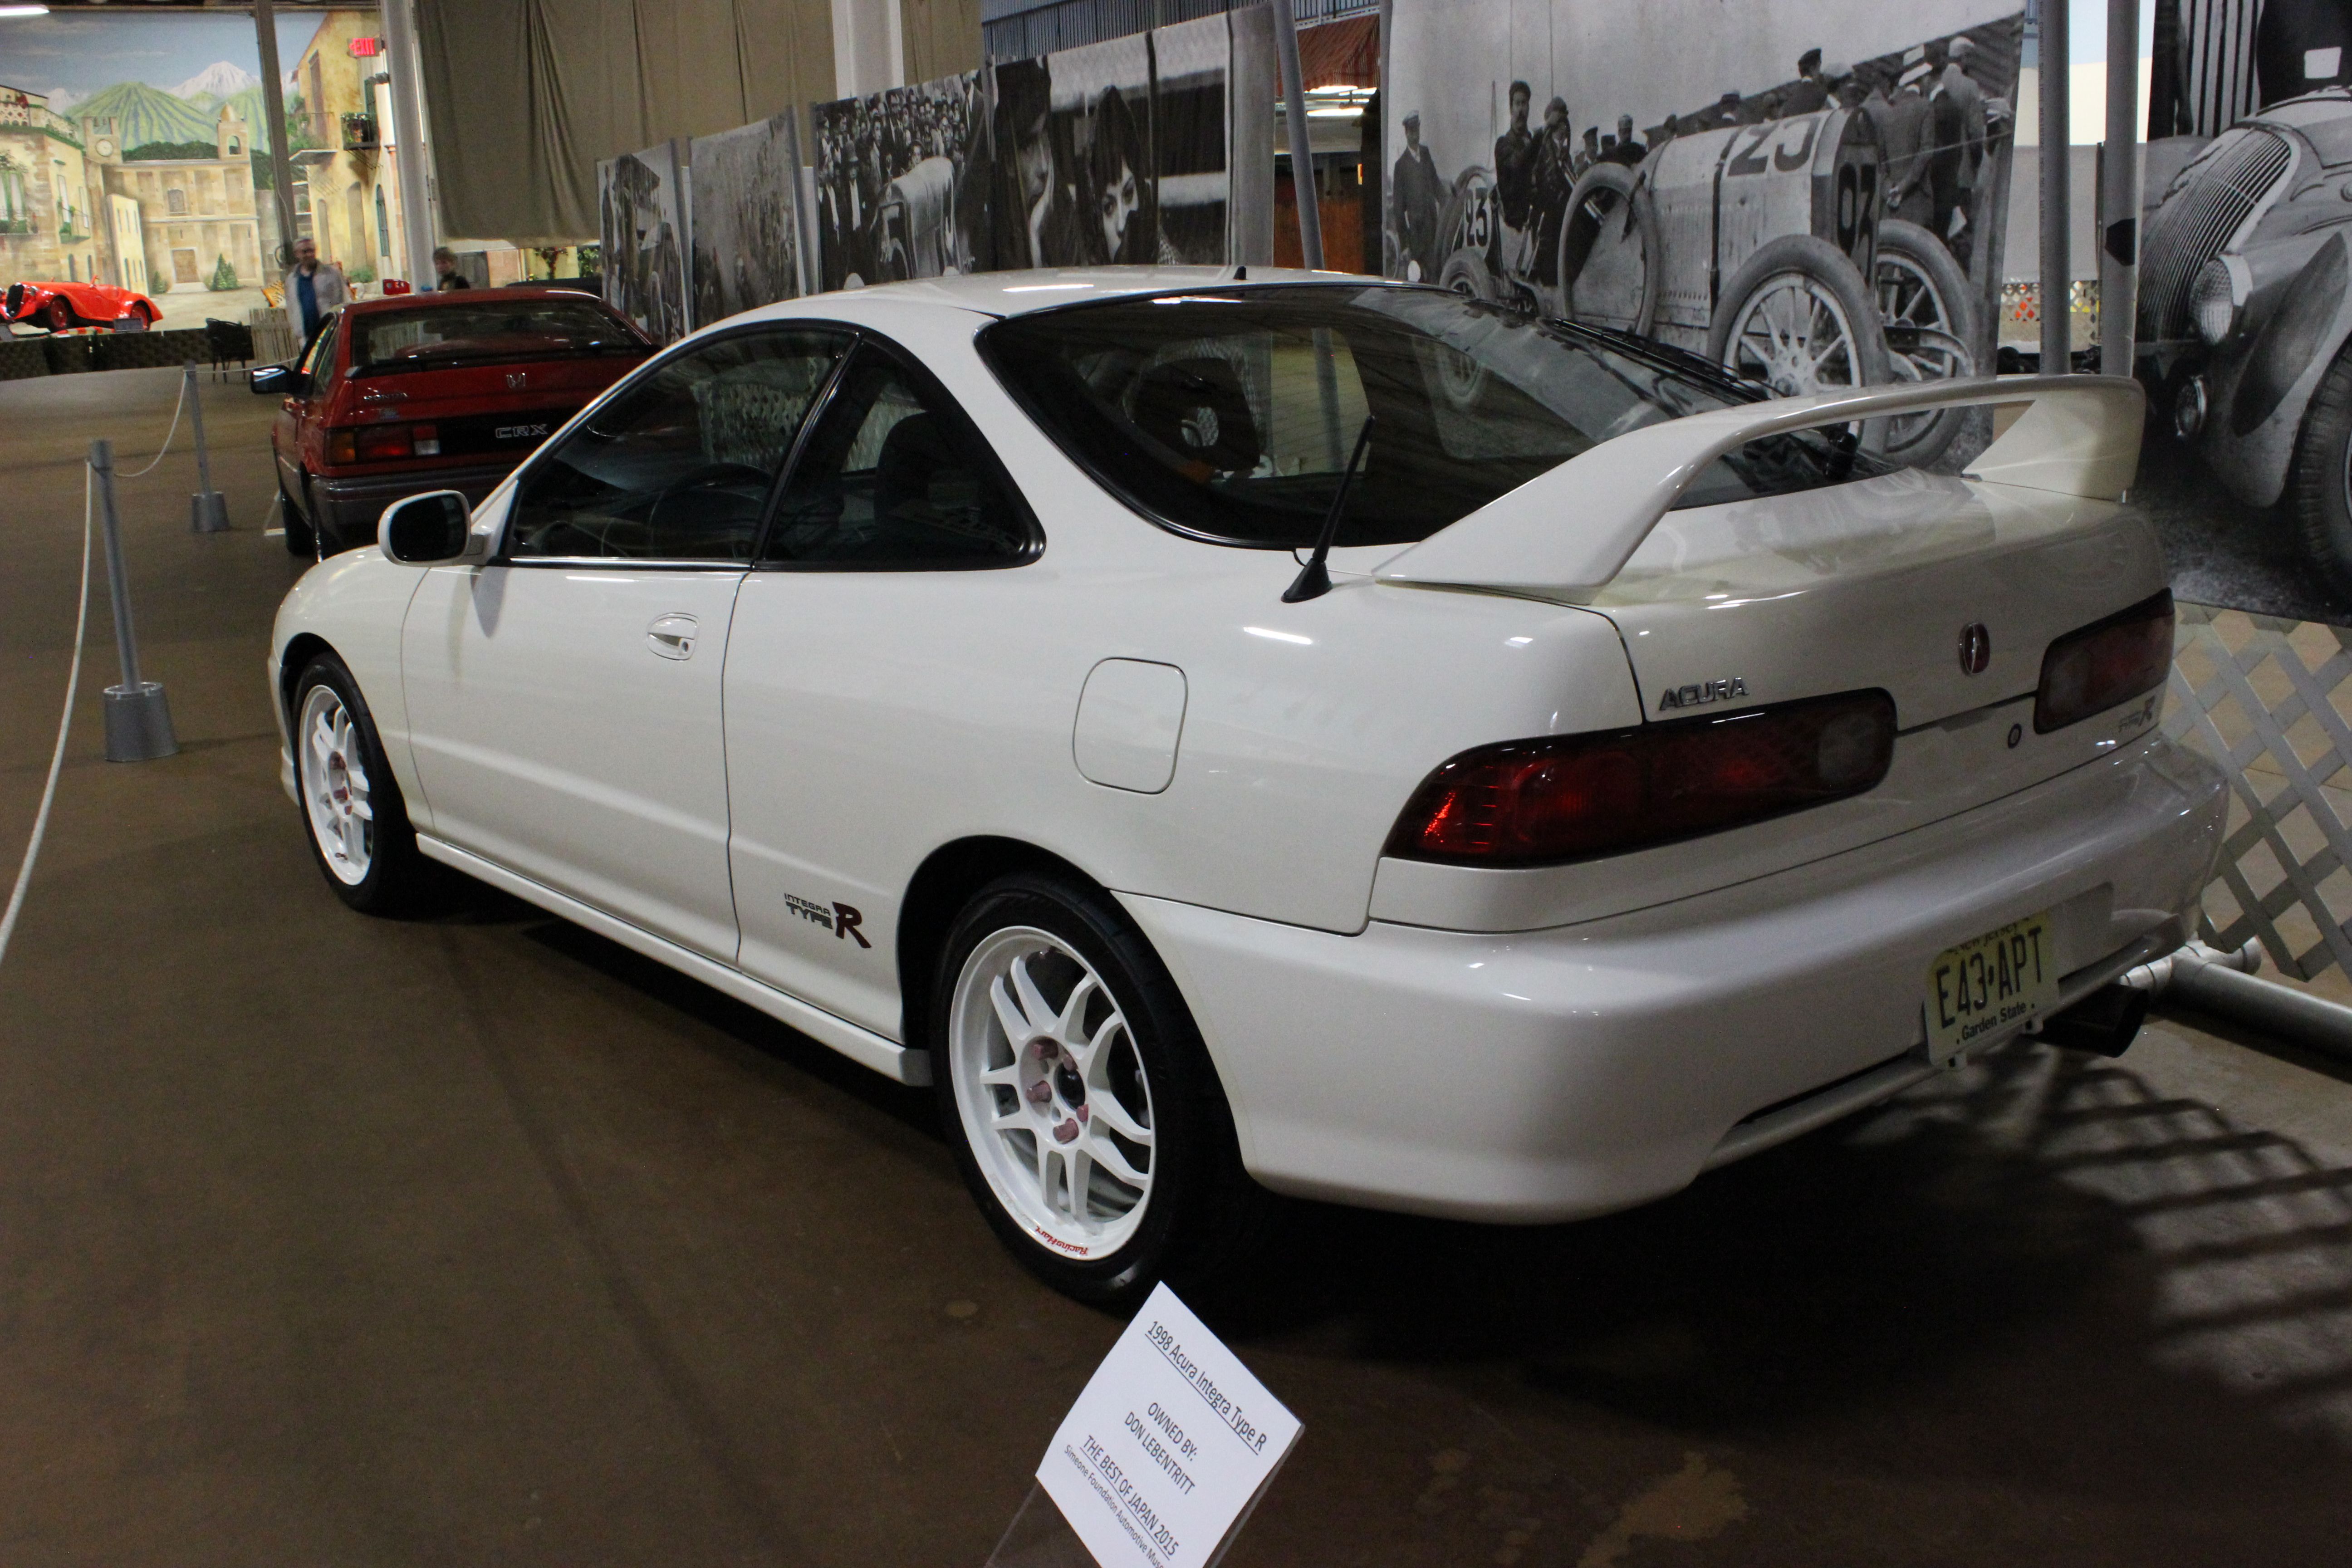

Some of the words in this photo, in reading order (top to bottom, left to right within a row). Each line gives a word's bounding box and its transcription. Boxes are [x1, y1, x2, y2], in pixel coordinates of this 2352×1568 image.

[353, 38, 375, 55] EXIT
[1466, 187, 1488, 247] 23
[495, 424, 548, 438] CRX
[1659, 677, 1750, 710] ACURA
[784, 893, 831, 916] INTEGRA
[786, 901, 833, 930] TYPE
[832, 901, 872, 948] R
[1961, 1016, 1997, 1040] Garden
[2000, 1002, 2027, 1023] State
[1148, 1321, 1173, 1350] 1998
[1169, 1344, 1198, 1380] Acura
[1196, 1371, 1231, 1415] Integra
[1230, 1406, 1256, 1441] Type
[1254, 1433, 1267, 1451] R
[1124, 1411, 1147, 1440] DON
[1142, 1433, 1196, 1495] LEBENTRITT
[1148, 1402, 1184, 1444] OWNED
[1181, 1439, 1198, 1462] BY:
[1064, 1445, 1089, 1477] Simeone
[1088, 1472, 1118, 1514] Foundation
[1116, 1509, 1148, 1553] Automotive
[1083, 1435, 1104, 1461] THE
[1099, 1455, 1123, 1484] BEST
[1119, 1479, 1133, 1497] OF
[1128, 1492, 1159, 1531] JAPAN
[1154, 1524, 1180, 1556] 2015
